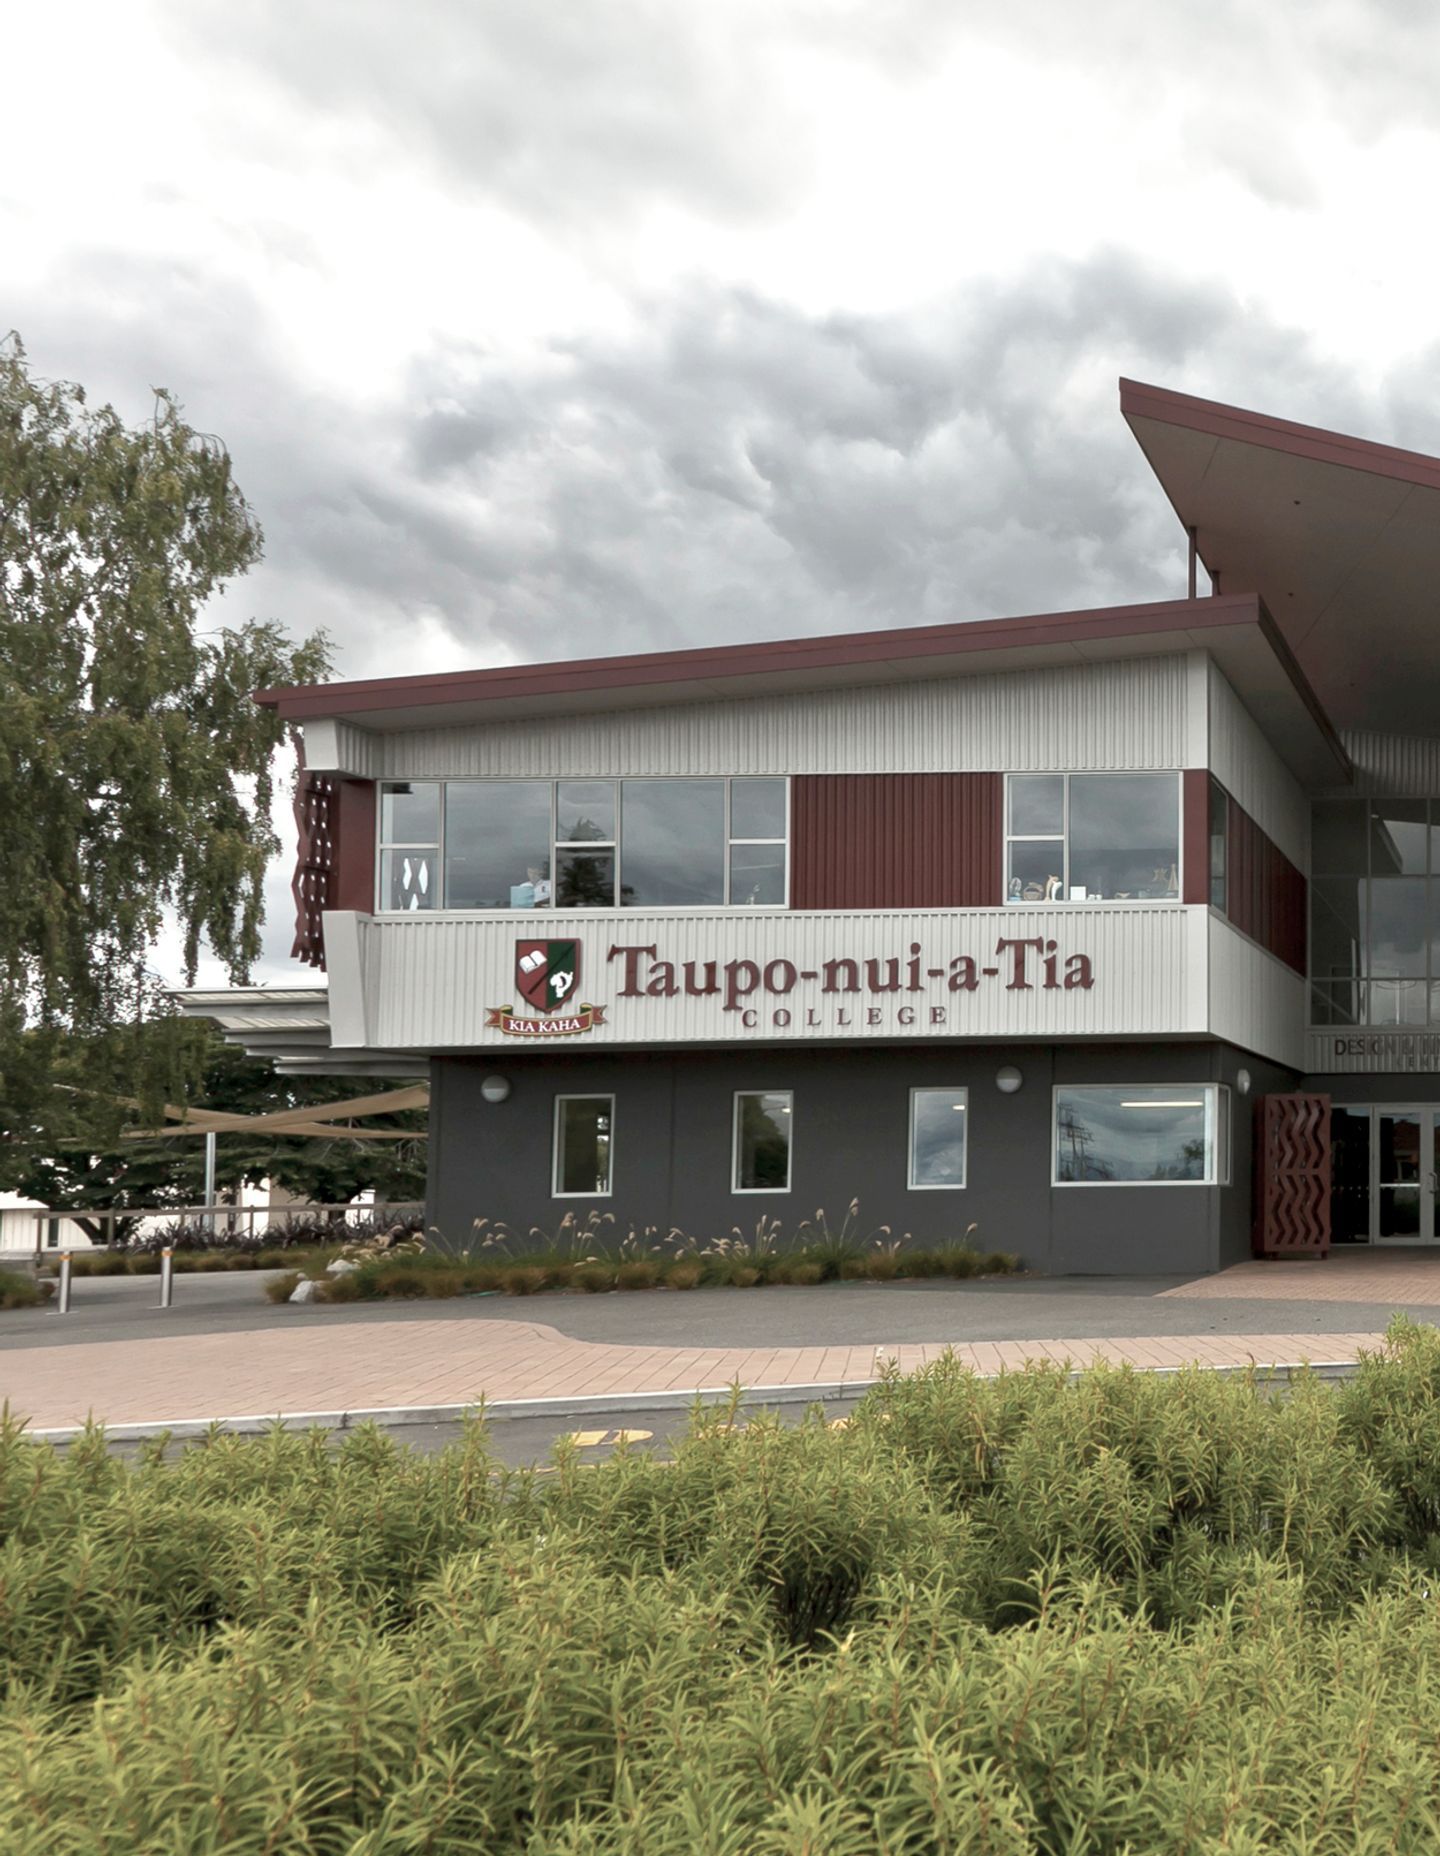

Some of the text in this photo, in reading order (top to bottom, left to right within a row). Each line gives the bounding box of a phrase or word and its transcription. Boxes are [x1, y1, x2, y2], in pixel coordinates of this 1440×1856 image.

[607, 936, 1094, 1011] Taupo-nui-a-Tia
[509, 1018, 581, 1032] KIA KAHA
[742, 1006, 947, 1028] COLLEGE
[1335, 1038, 1396, 1056] DESIGN
